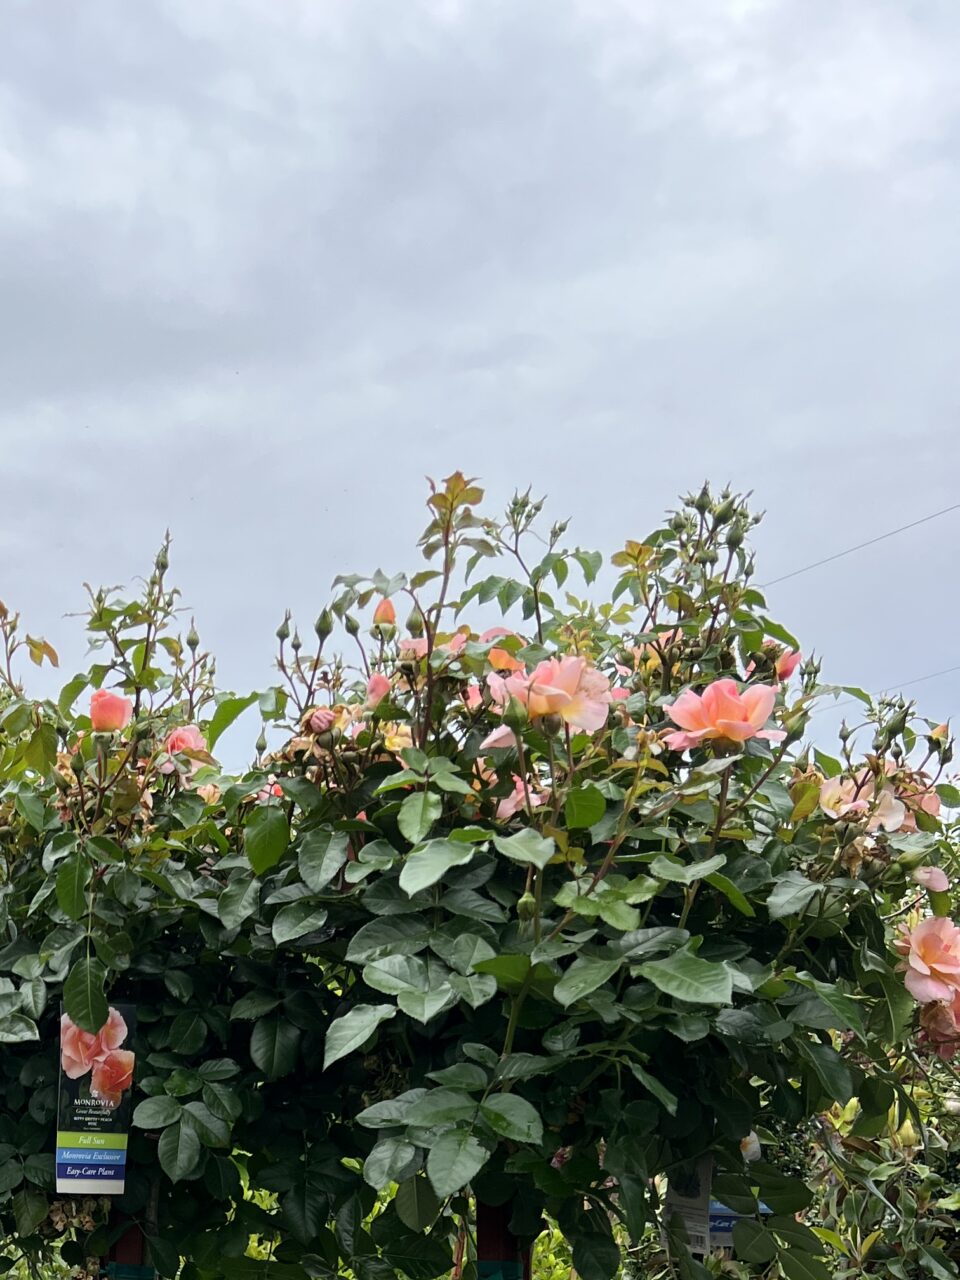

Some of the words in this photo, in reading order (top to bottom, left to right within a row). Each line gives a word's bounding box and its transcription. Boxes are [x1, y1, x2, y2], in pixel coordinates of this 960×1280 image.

[73, 1098, 114, 1107] MONROVIA
[78, 1135, 91, 1144] Full
[92, 1137, 105, 1145] Sun
[62, 1150, 91, 1160] Monrovia
[92, 1151, 120, 1160] Exclusive
[66, 1166, 96, 1177] Easy-Care
[98, 1167, 115, 1176] Plant
